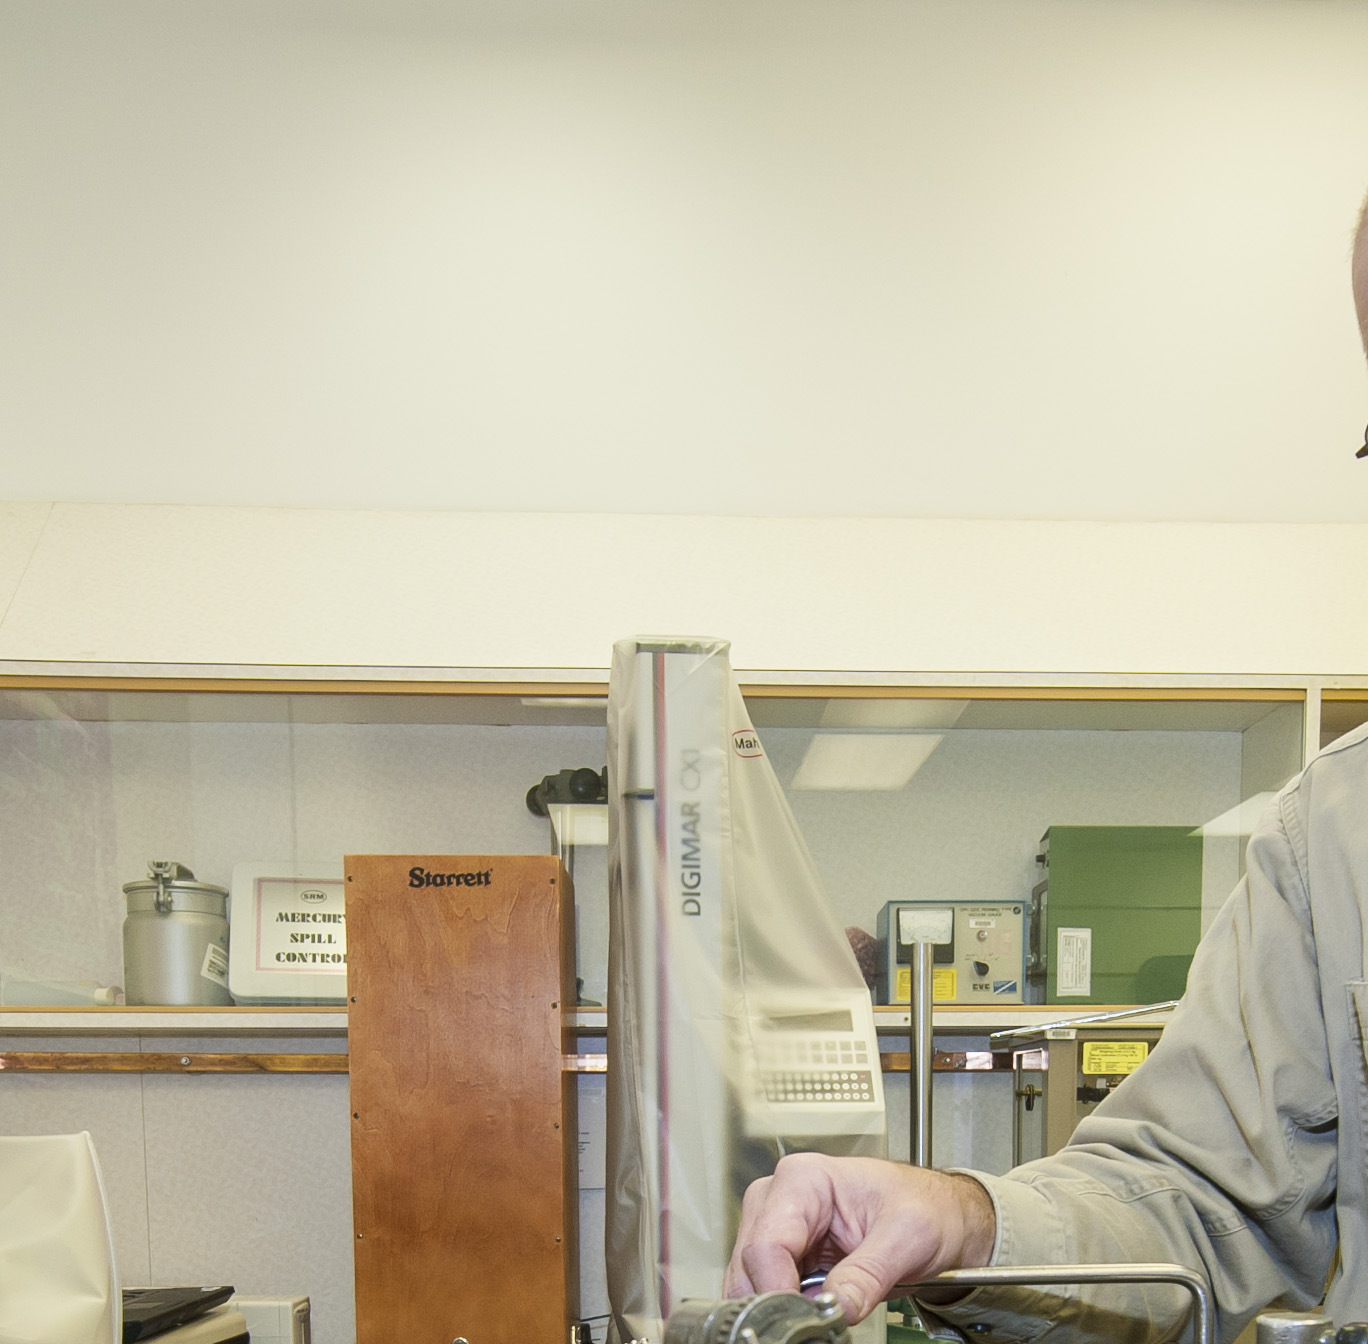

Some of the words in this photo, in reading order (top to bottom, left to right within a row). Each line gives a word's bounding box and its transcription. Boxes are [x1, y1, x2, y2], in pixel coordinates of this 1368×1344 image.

[680, 802, 701, 916] DIGIMAR
[408, 866, 492, 888] Starrett
[289, 932, 336, 944] SPILL
